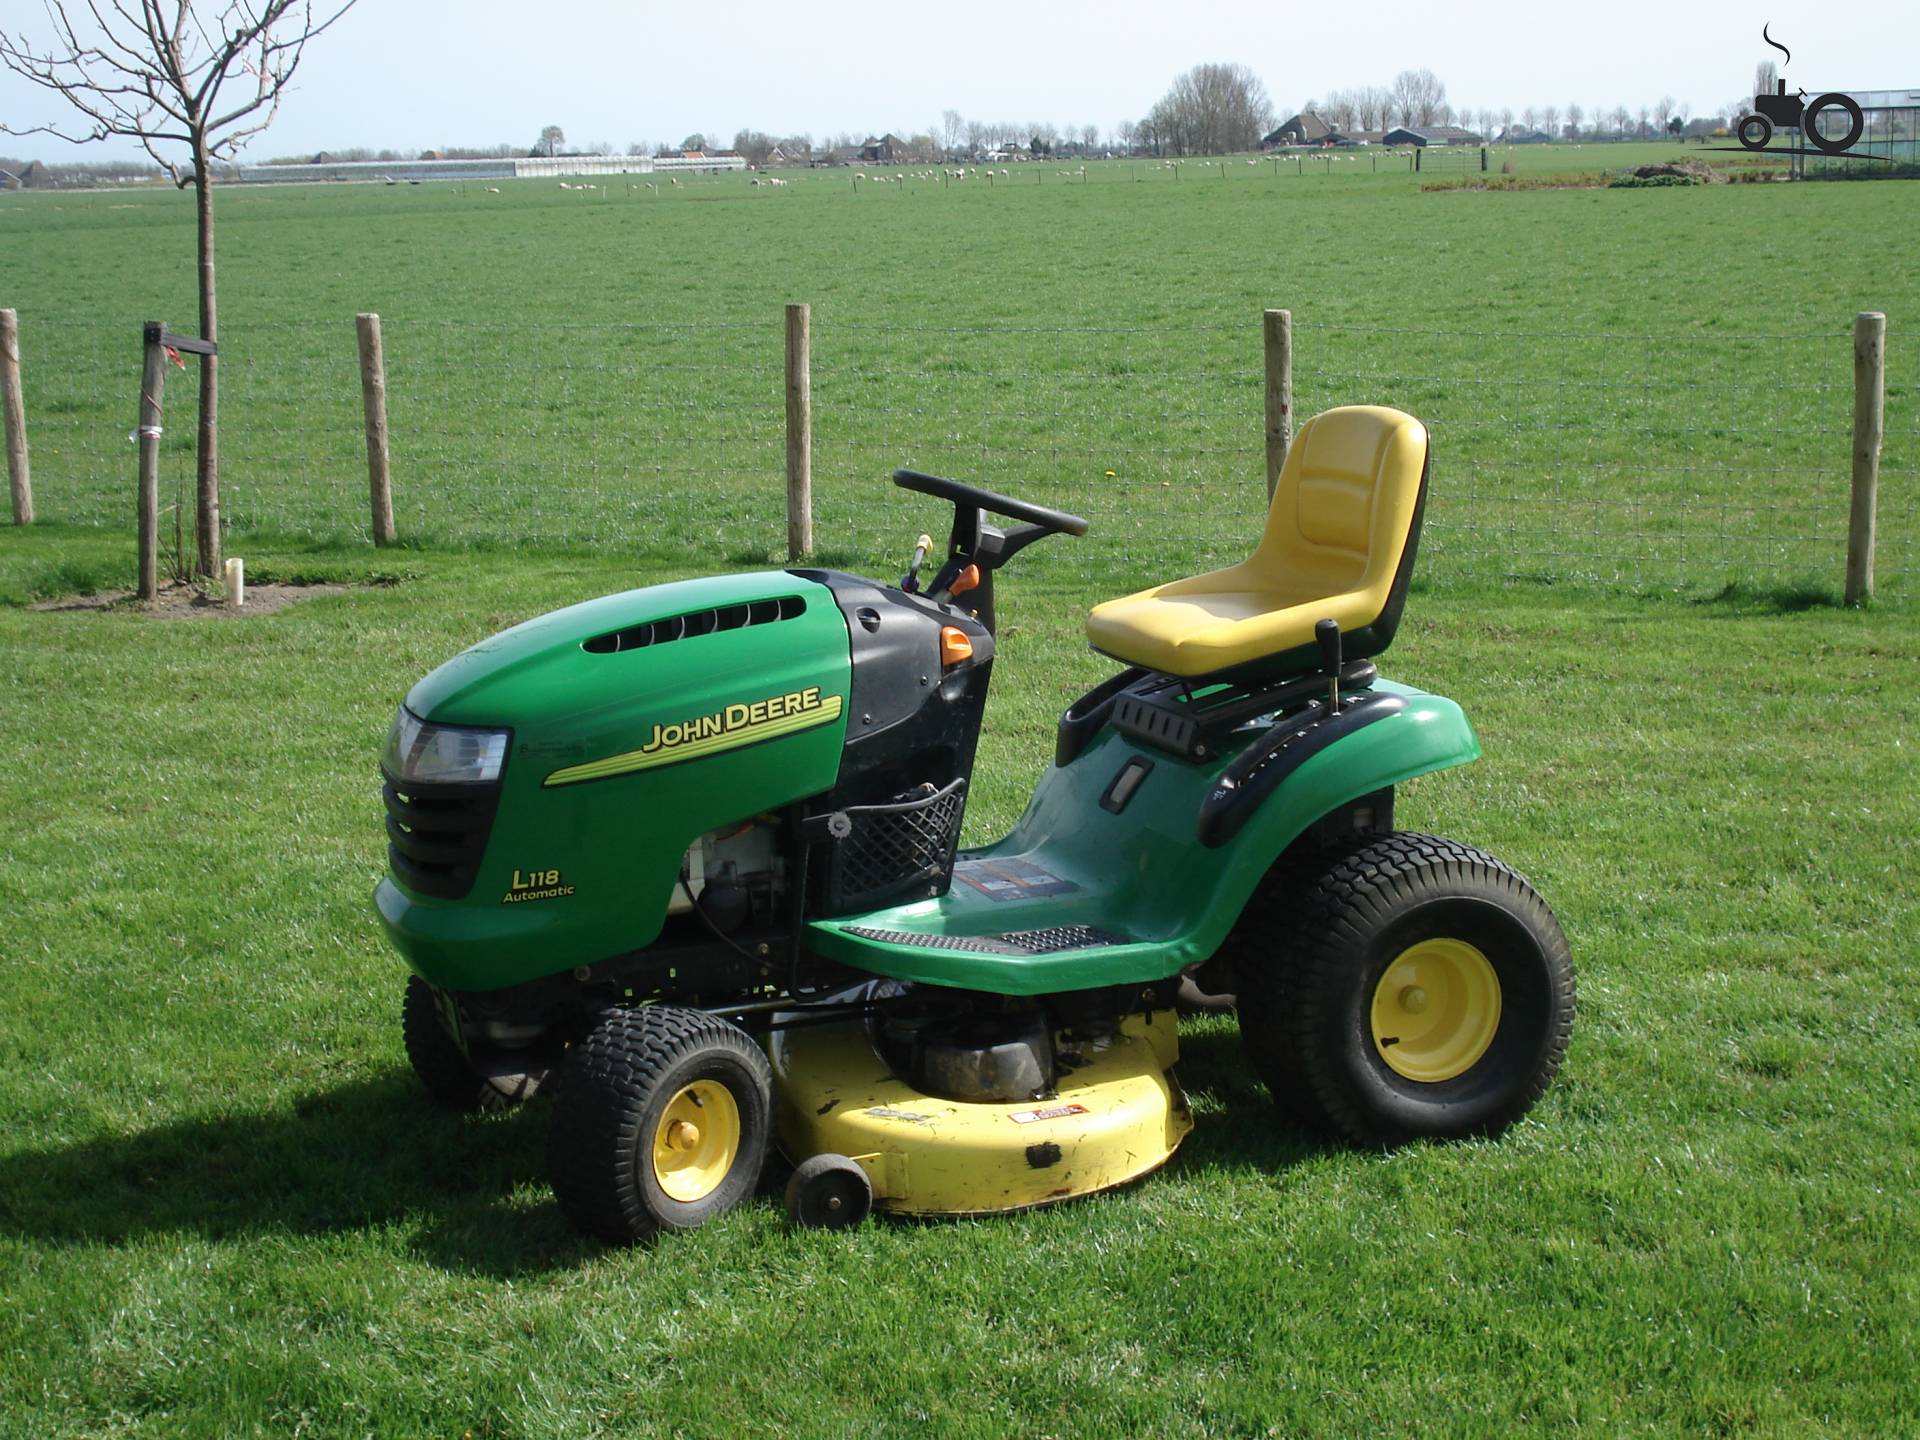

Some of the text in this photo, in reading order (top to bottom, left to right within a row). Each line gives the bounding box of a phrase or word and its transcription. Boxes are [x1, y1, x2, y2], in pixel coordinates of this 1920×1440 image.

[643, 688, 820, 752] JOHN DEERE
[512, 869, 560, 890] L118
[503, 885, 575, 903] Automatic
